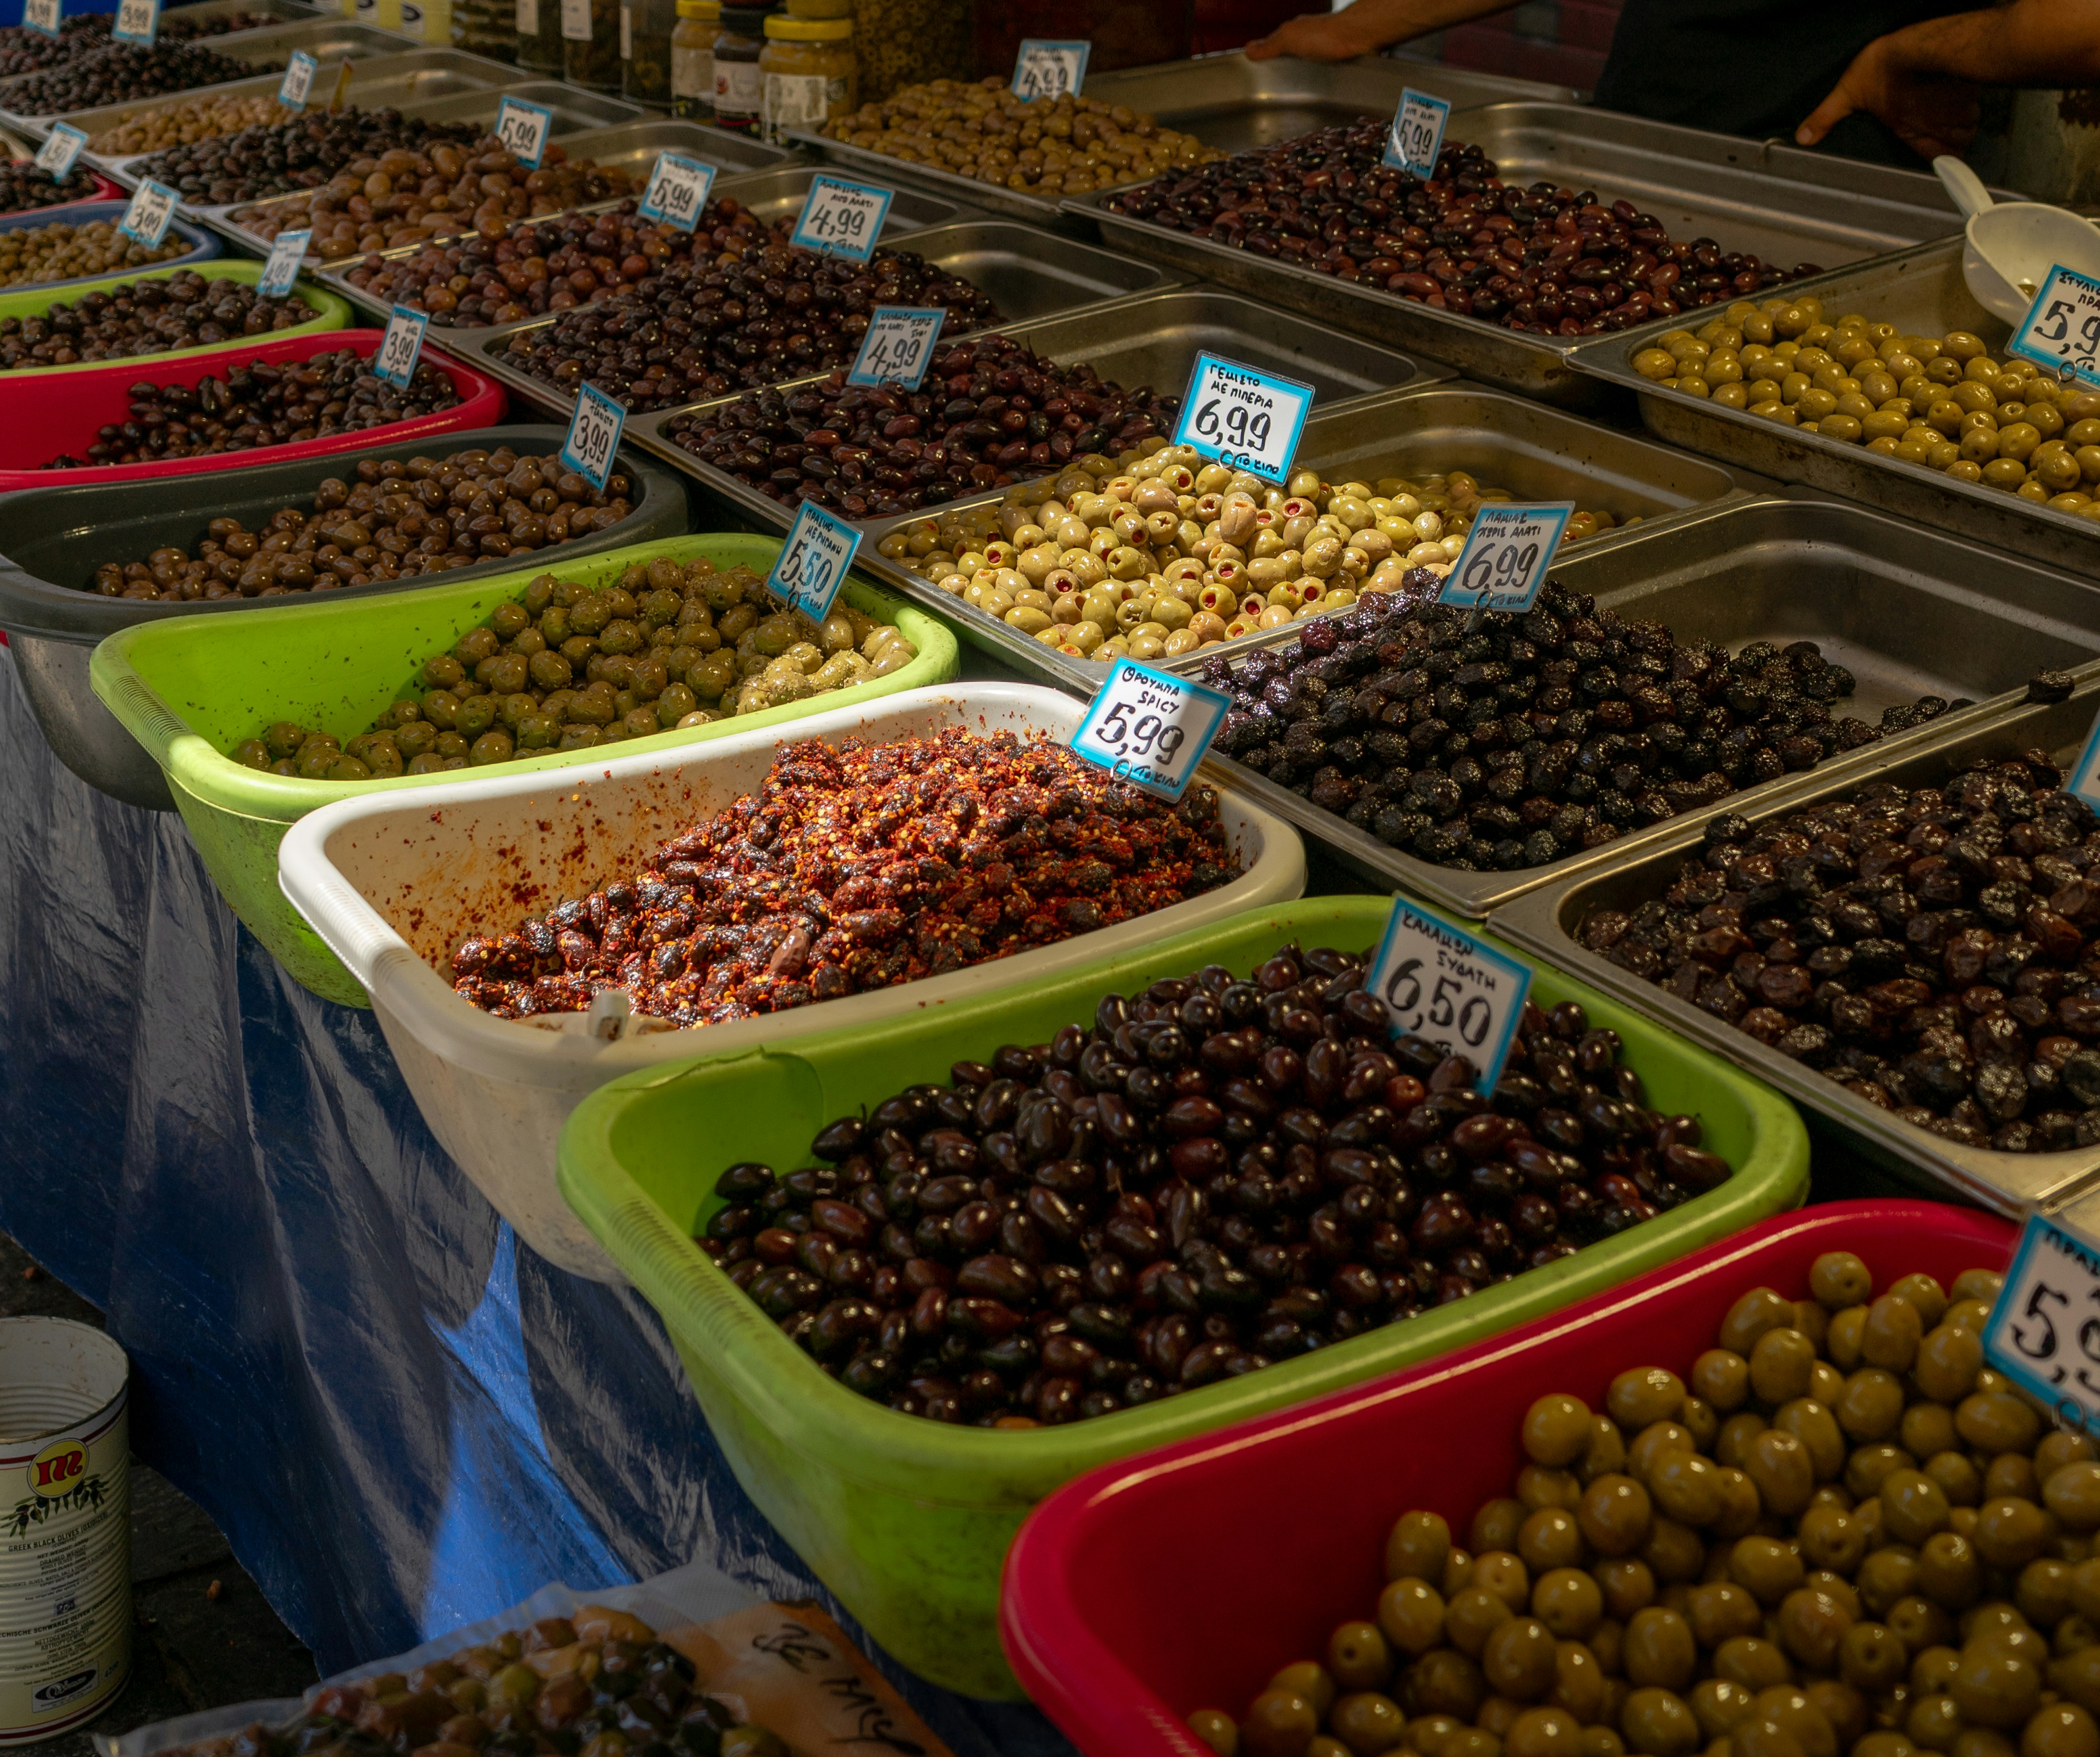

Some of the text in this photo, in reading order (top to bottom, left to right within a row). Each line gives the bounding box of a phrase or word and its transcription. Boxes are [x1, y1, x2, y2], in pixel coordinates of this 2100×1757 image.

[651, 178, 694, 214] 5,99
[810, 204, 865, 236] 4,99
[867, 335, 921, 374] 4,99
[574, 414, 609, 464] 3,99
[1195, 399, 1271, 451] 6,99
[781, 539, 833, 594] 5,50
[1462, 543, 1539, 590] 6,99
[1137, 691, 1180, 714] SPICY
[1096, 702, 1184, 765] 5,99
[1385, 958, 1491, 1047] 6,50
[8, 1543, 32, 1552] GREEK
[33, 1537, 56, 1548] BLACK
[57, 1528, 80, 1541] OLIVES
[34, 1620, 69, 1633] SCHWARZE
